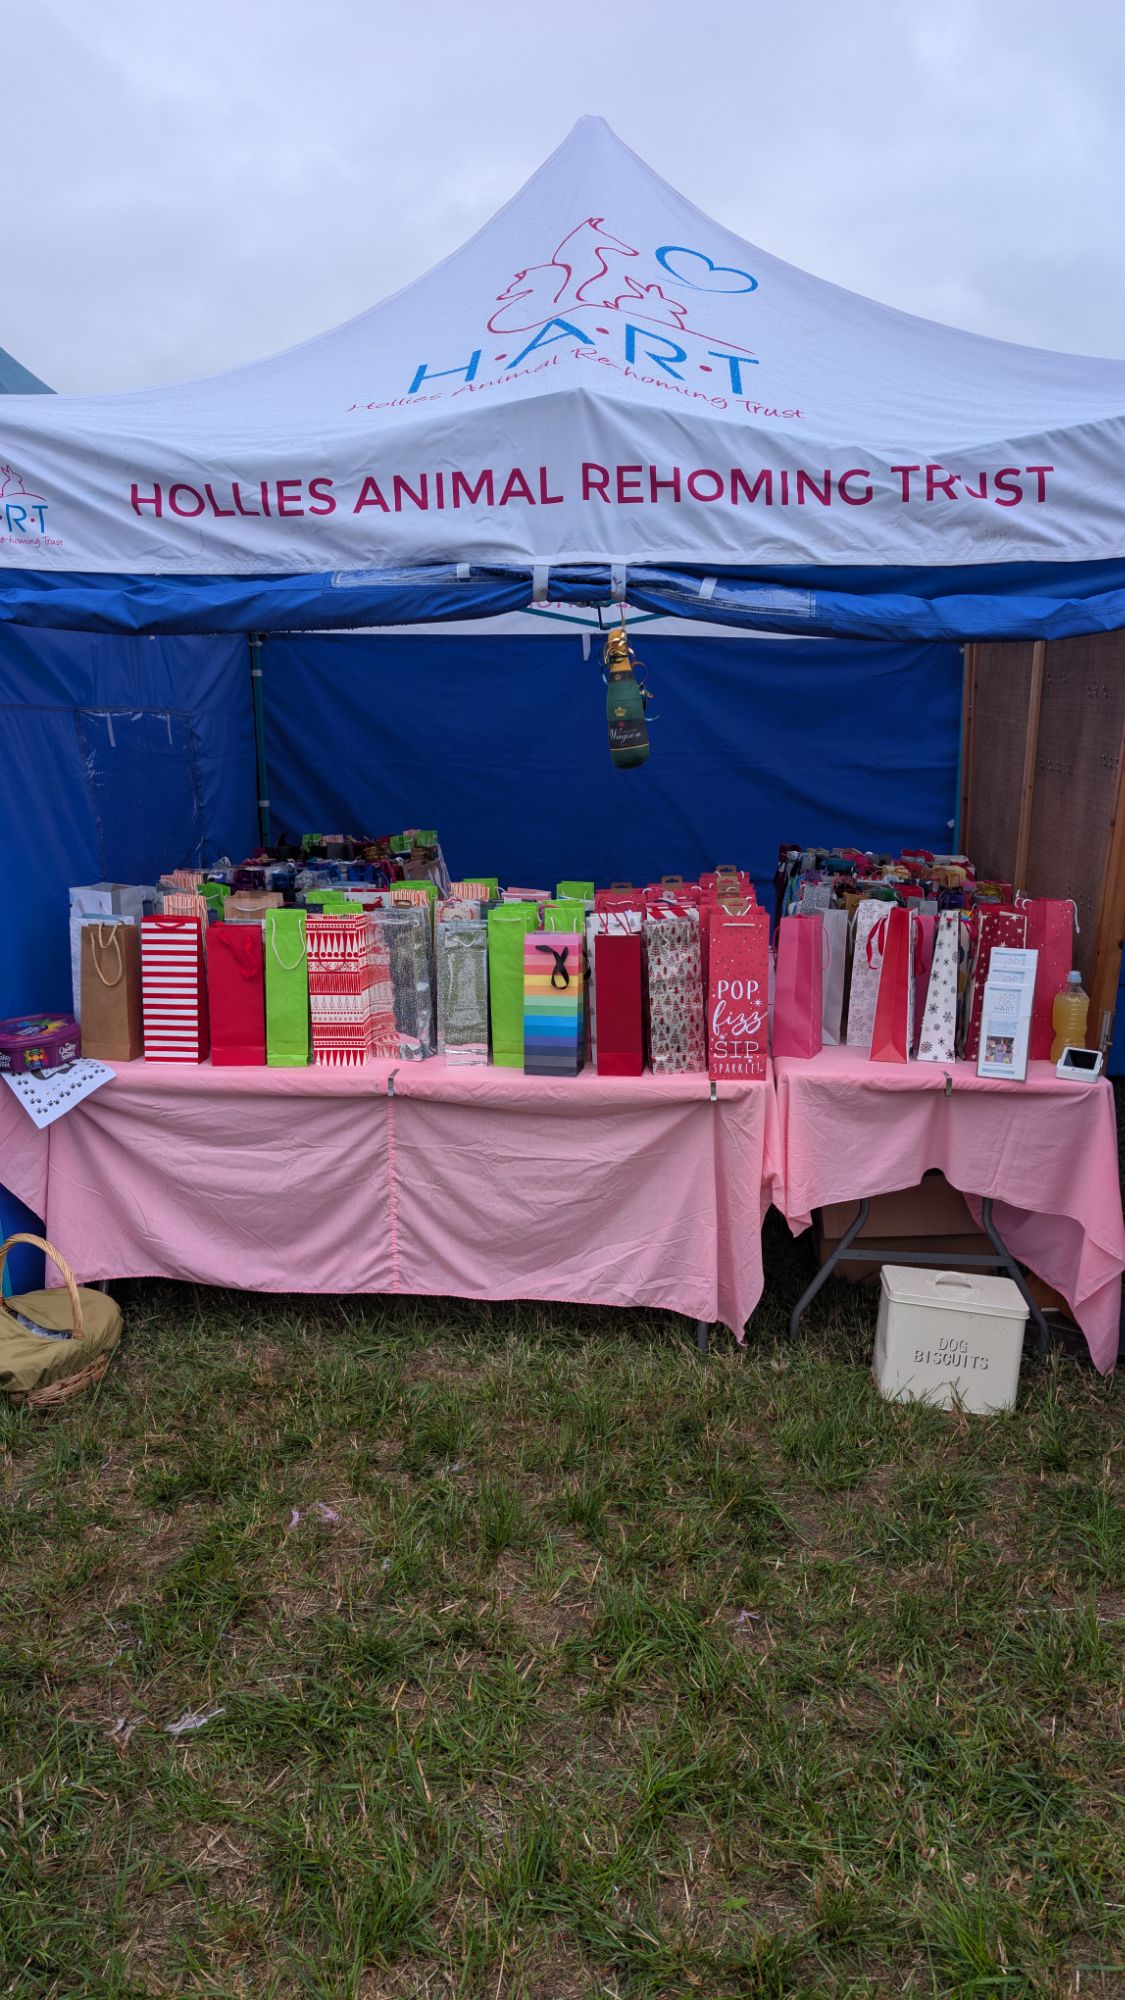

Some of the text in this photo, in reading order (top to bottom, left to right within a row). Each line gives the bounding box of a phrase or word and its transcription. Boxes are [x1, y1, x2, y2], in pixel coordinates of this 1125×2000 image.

[345, 392, 442, 413] Hollies
[449, 354, 559, 397] Animal
[735, 399, 806, 419] Trust
[131, 462, 1054, 518] HOLLIES ANIMAL REHOMING TRUST
[41, 536, 64, 546] Trust
[717, 979, 759, 1000] POP
[712, 1000, 769, 1036] fizz
[713, 1040, 759, 1059] SIP
[938, 1337, 968, 1353] DOG
[914, 1350, 989, 1370] BISCUITS
